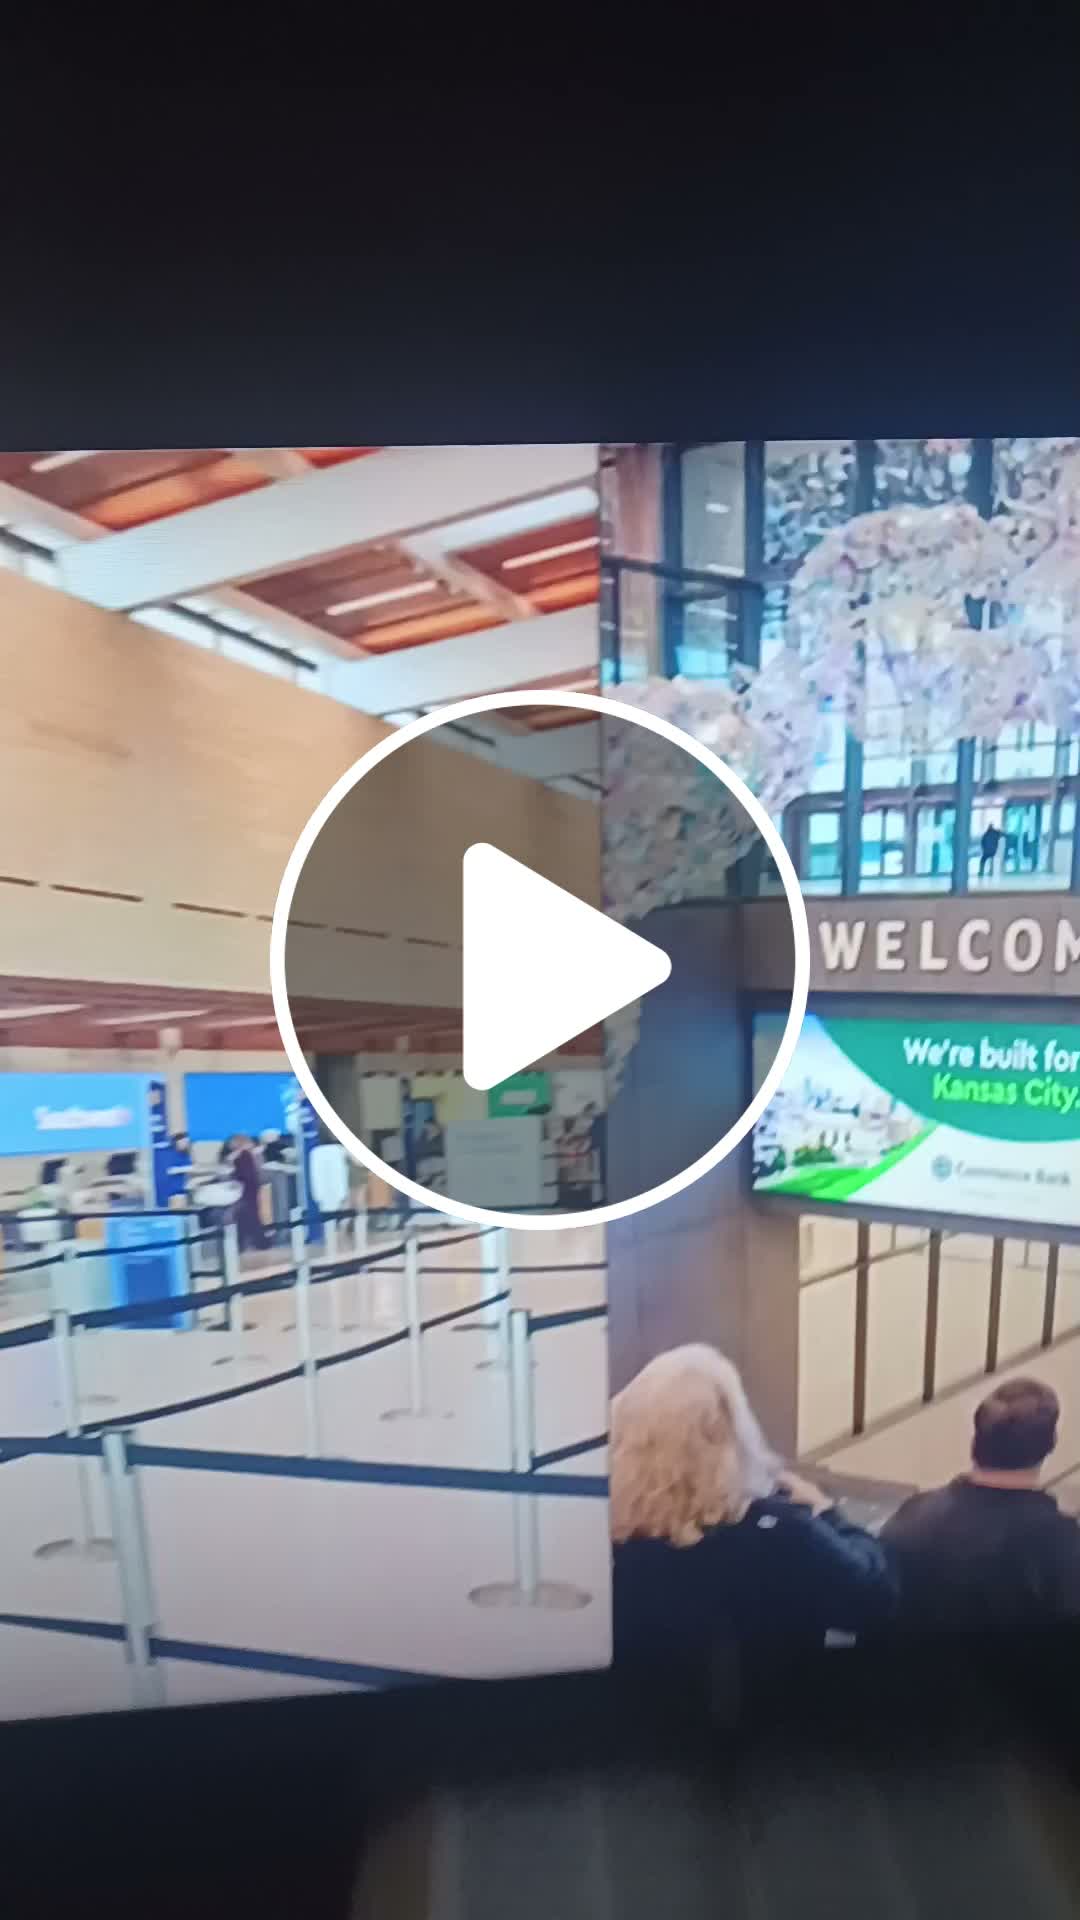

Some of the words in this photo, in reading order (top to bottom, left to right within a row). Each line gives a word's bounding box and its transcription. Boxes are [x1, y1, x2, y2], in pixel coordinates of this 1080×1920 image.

[903, 1037, 975, 1068] We're
[979, 1035, 1038, 1072] built
[1043, 1039, 1080, 1073] for
[932, 1072, 1017, 1105] Kansas
